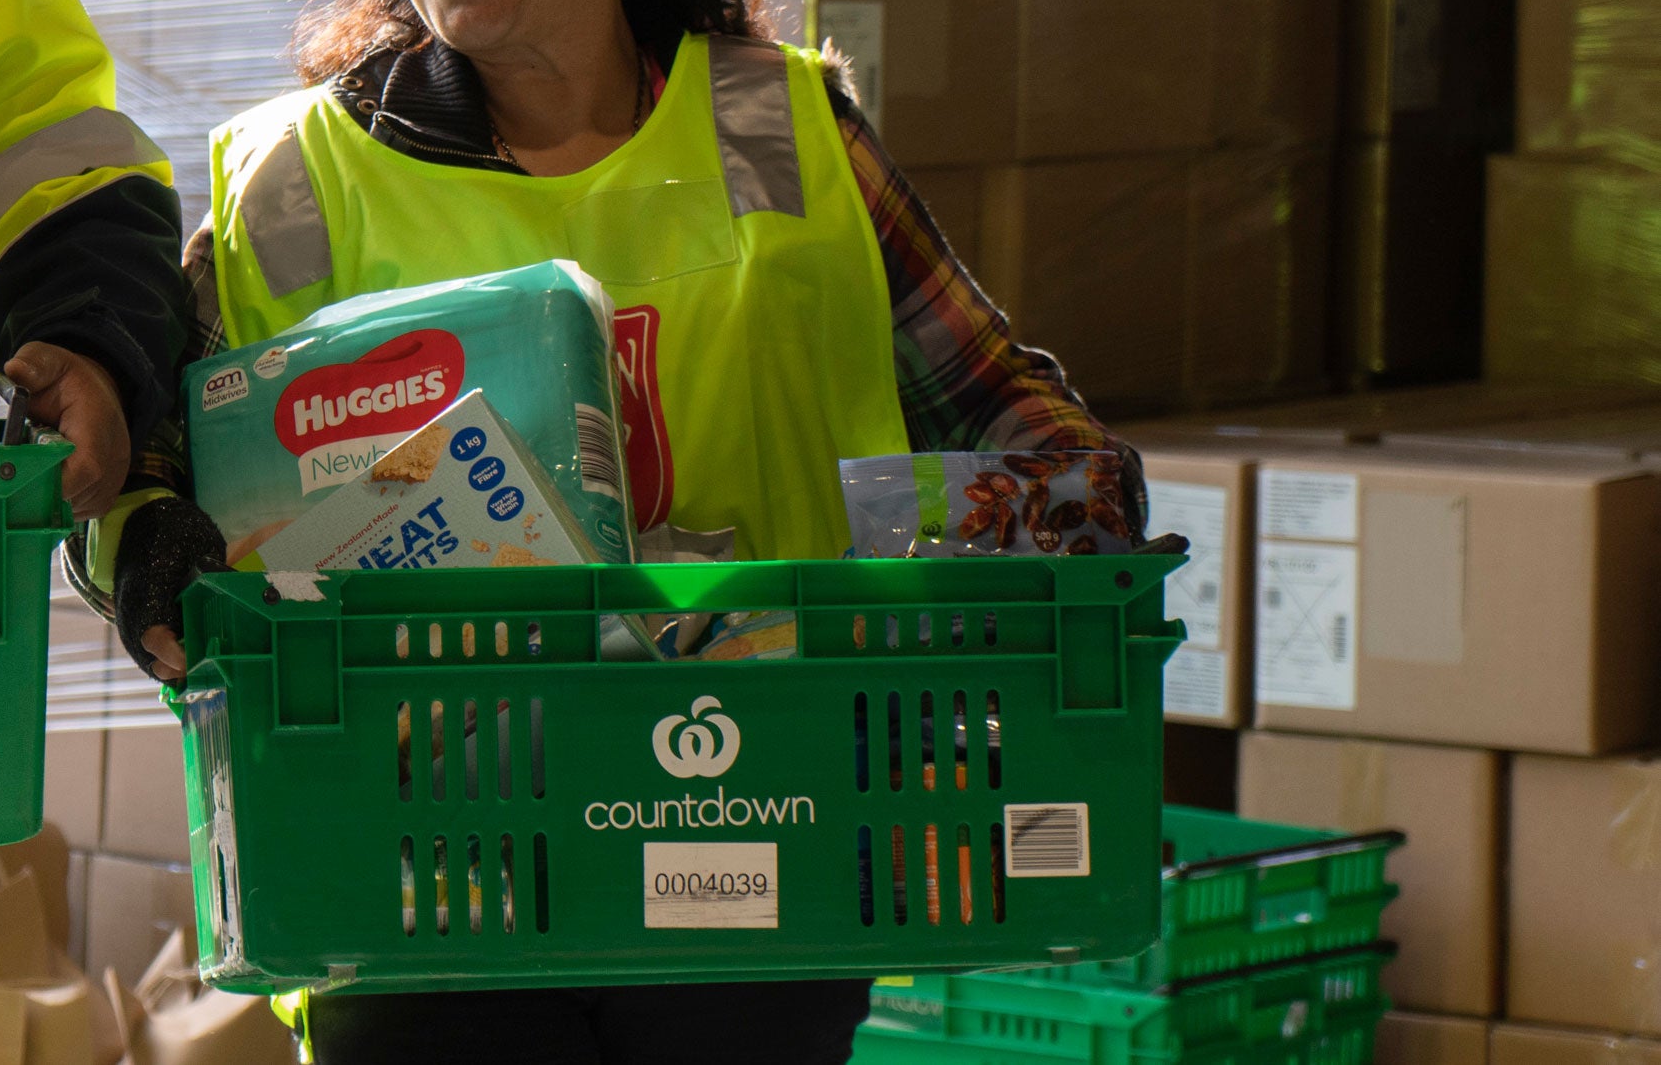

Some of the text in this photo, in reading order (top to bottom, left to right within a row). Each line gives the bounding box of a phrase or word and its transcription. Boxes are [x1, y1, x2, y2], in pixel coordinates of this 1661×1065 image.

[206, 369, 244, 393] acm
[203, 385, 248, 410] Midwives
[293, 370, 447, 437] HUGGIES
[456, 435, 482, 455] 1 kg
[311, 445, 389, 482] Newb
[477, 468, 499, 485] Fibre
[314, 503, 400, 570] New Zealand Made
[1035, 531, 1052, 542] 500
[584, 785, 816, 831] countdown
[654, 872, 769, 897] 0004039
